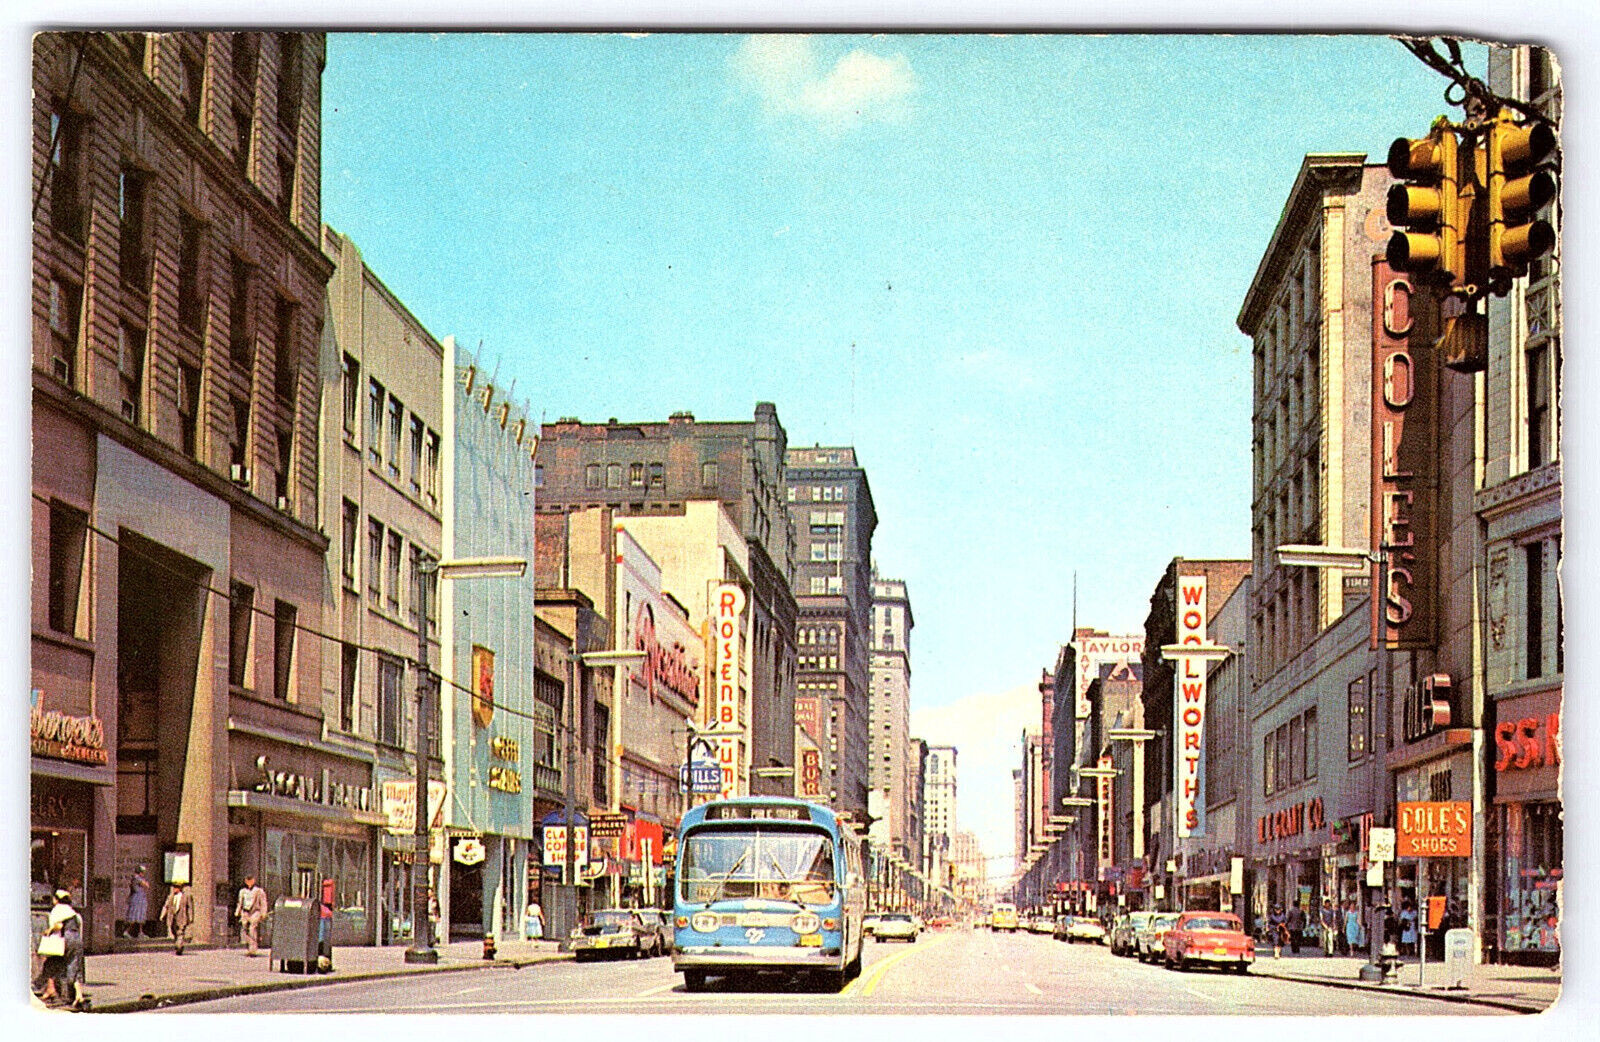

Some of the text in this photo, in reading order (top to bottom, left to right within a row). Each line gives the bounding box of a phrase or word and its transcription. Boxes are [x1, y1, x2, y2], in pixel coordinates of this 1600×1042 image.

[1383, 278, 1414, 623] COLE'S
[1402, 803, 1467, 834] COLE'S
[1411, 838, 1457, 852] SHOES
